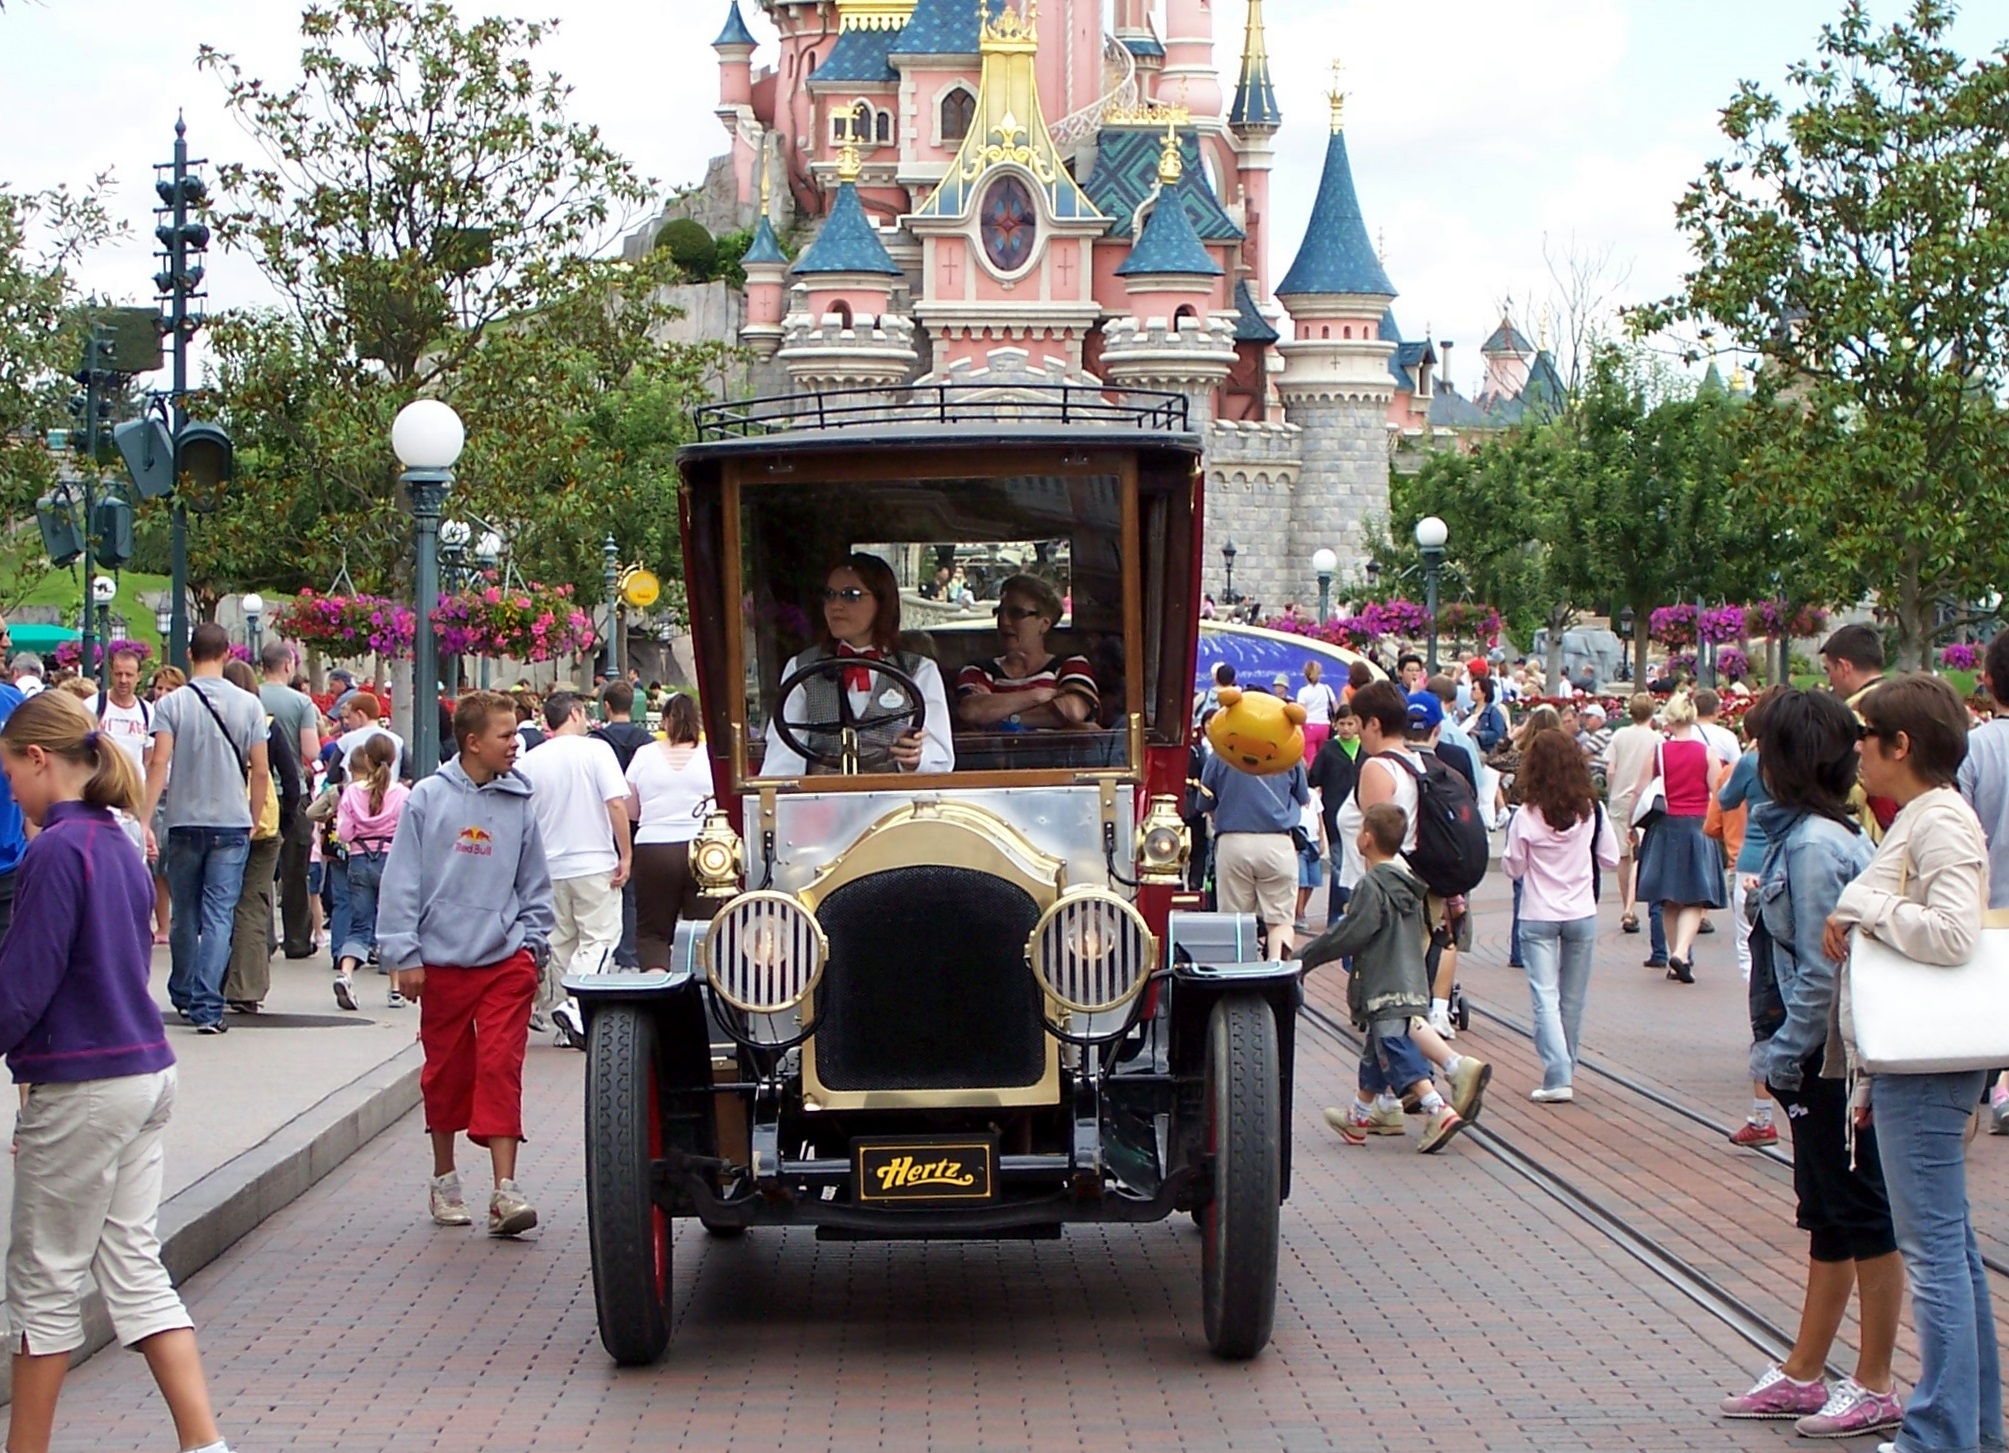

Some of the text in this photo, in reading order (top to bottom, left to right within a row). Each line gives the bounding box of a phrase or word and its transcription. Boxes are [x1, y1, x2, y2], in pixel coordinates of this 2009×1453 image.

[455, 842, 492, 856] Red Bull
[876, 1155, 974, 1190] Hertz
